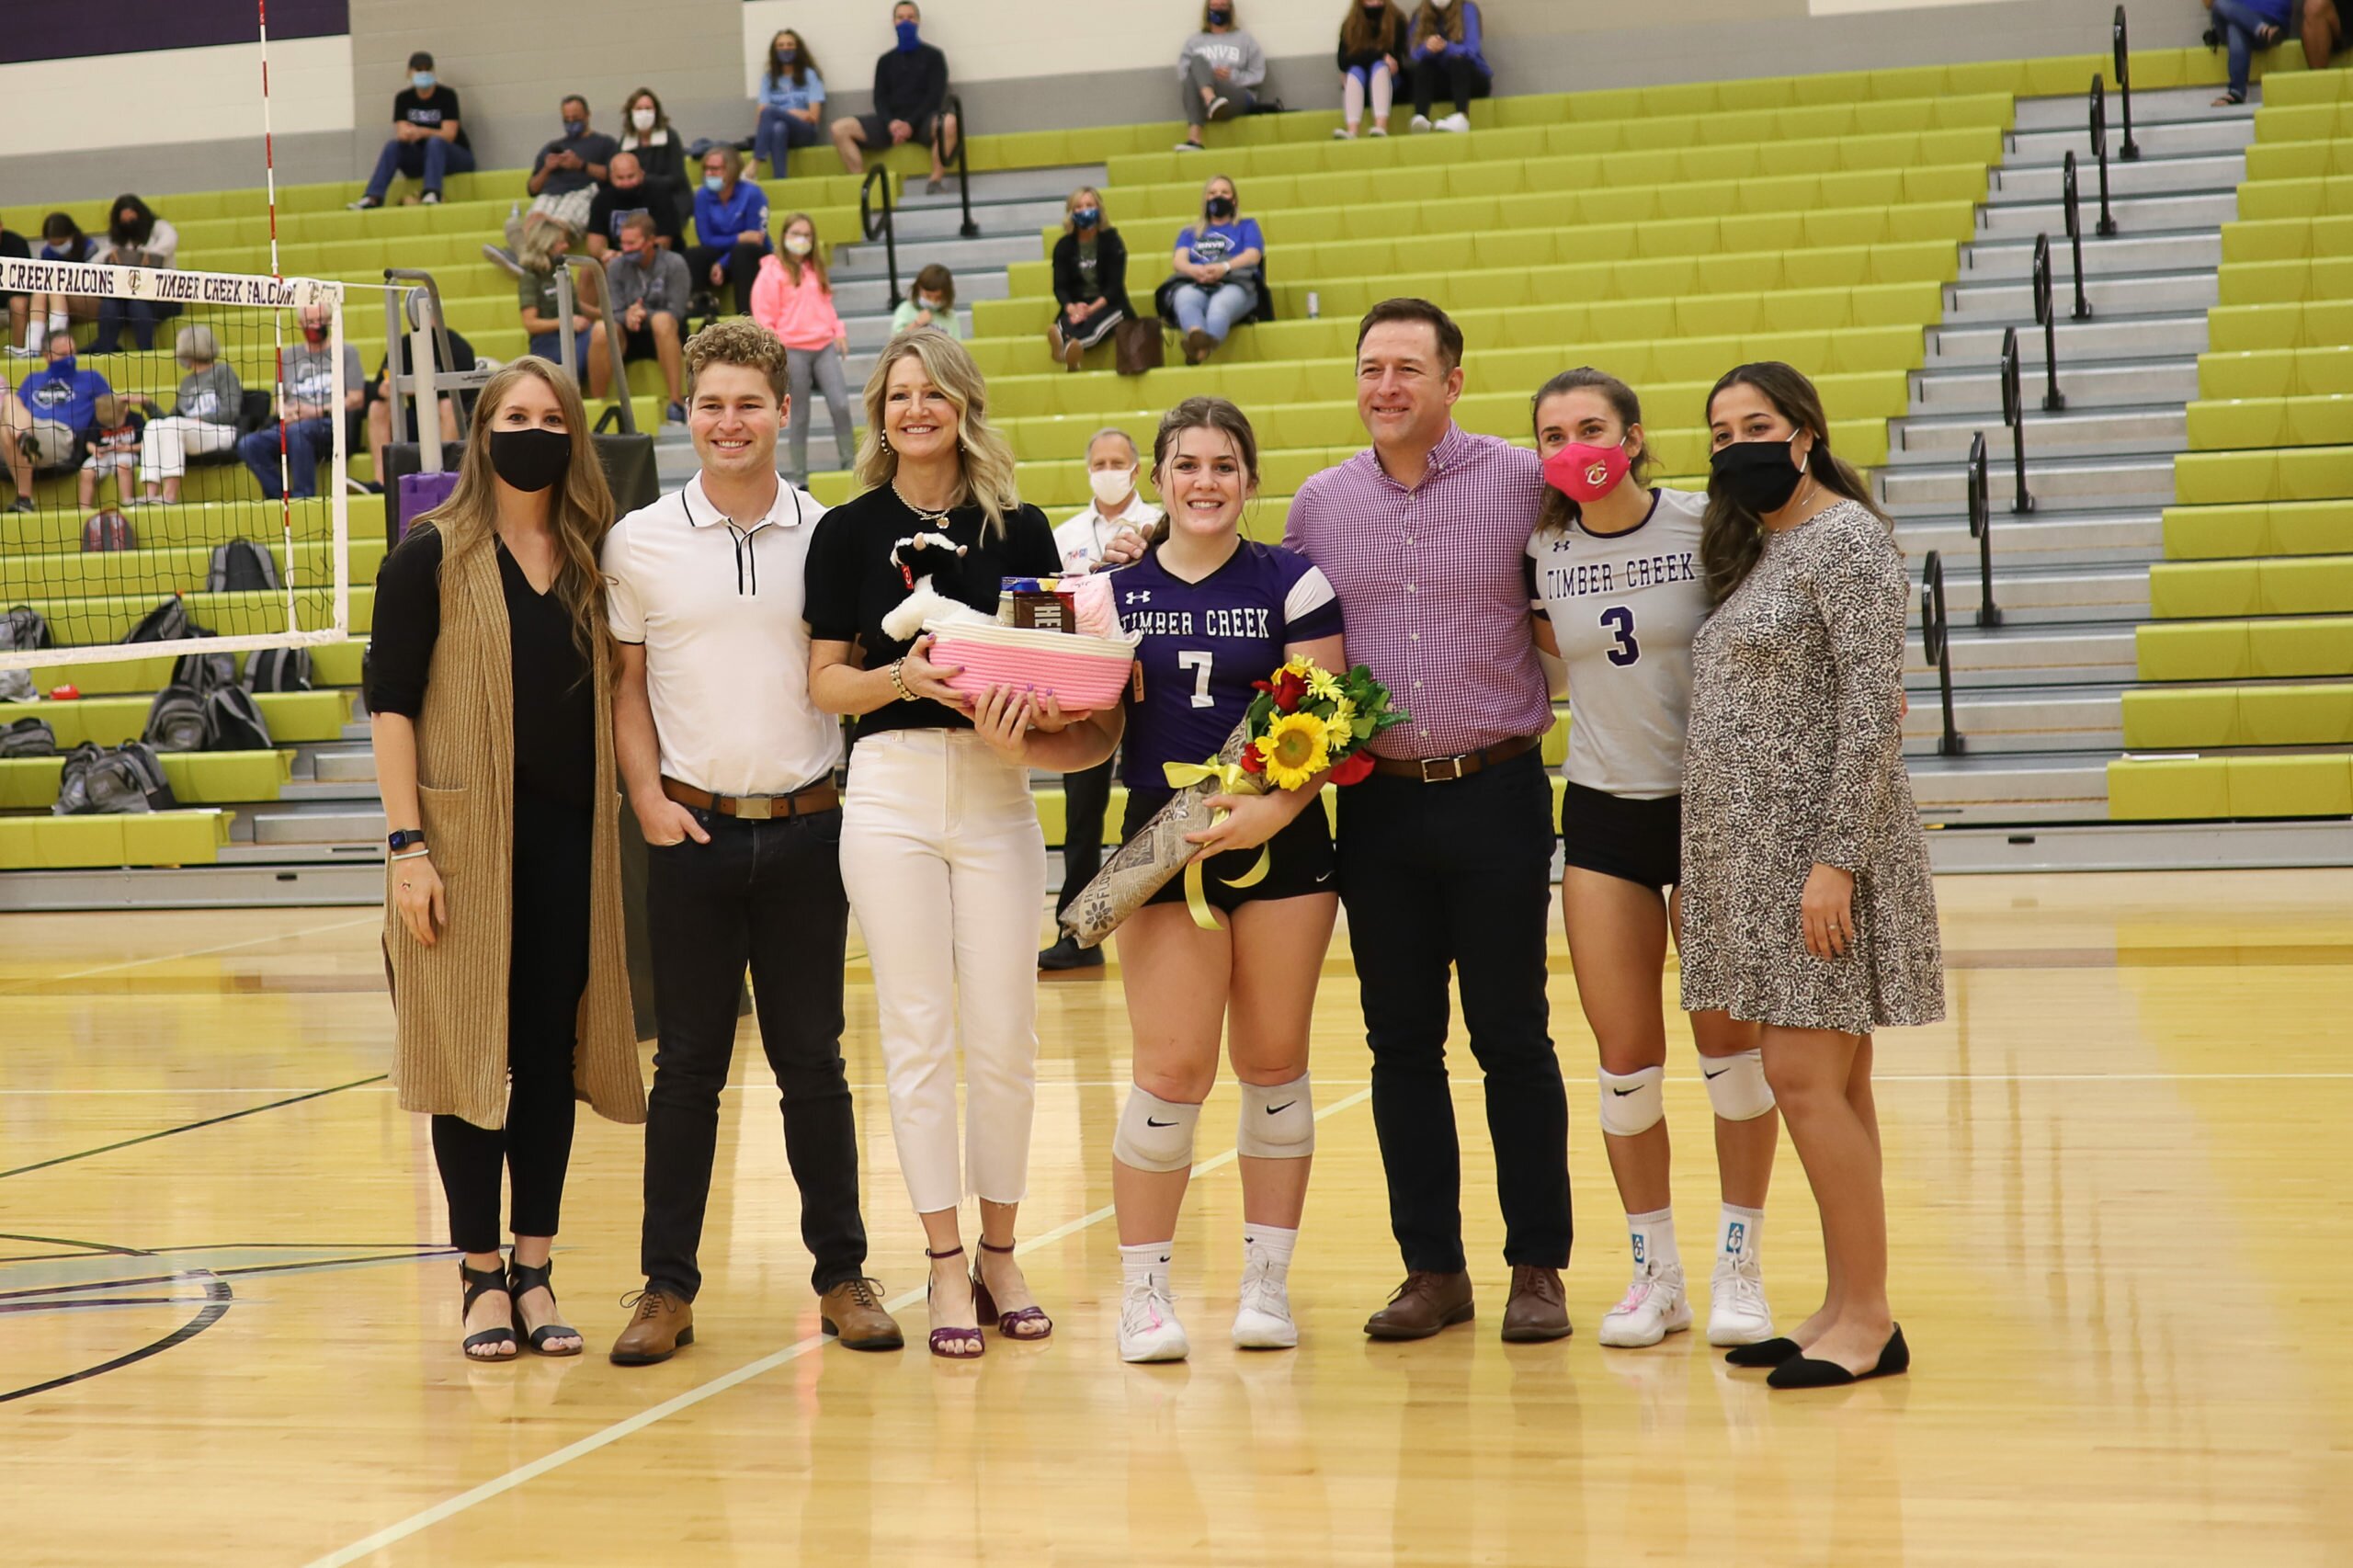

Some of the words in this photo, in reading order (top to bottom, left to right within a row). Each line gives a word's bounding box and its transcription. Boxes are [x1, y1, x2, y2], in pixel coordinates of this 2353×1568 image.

[9, 264, 54, 290] CREEK
[57, 267, 114, 294] FALCONS
[155, 274, 199, 300] TIMBER
[204, 278, 243, 302] CREEK
[1548, 563, 1613, 600] TIMBER
[1626, 553, 1695, 588] CREEK
[1034, 606, 1062, 631] HE
[1120, 611, 1193, 635] TIMBER
[1206, 608, 1269, 638] CREEK
[1598, 604, 1642, 668] 3
[1178, 651, 1214, 709] 7
